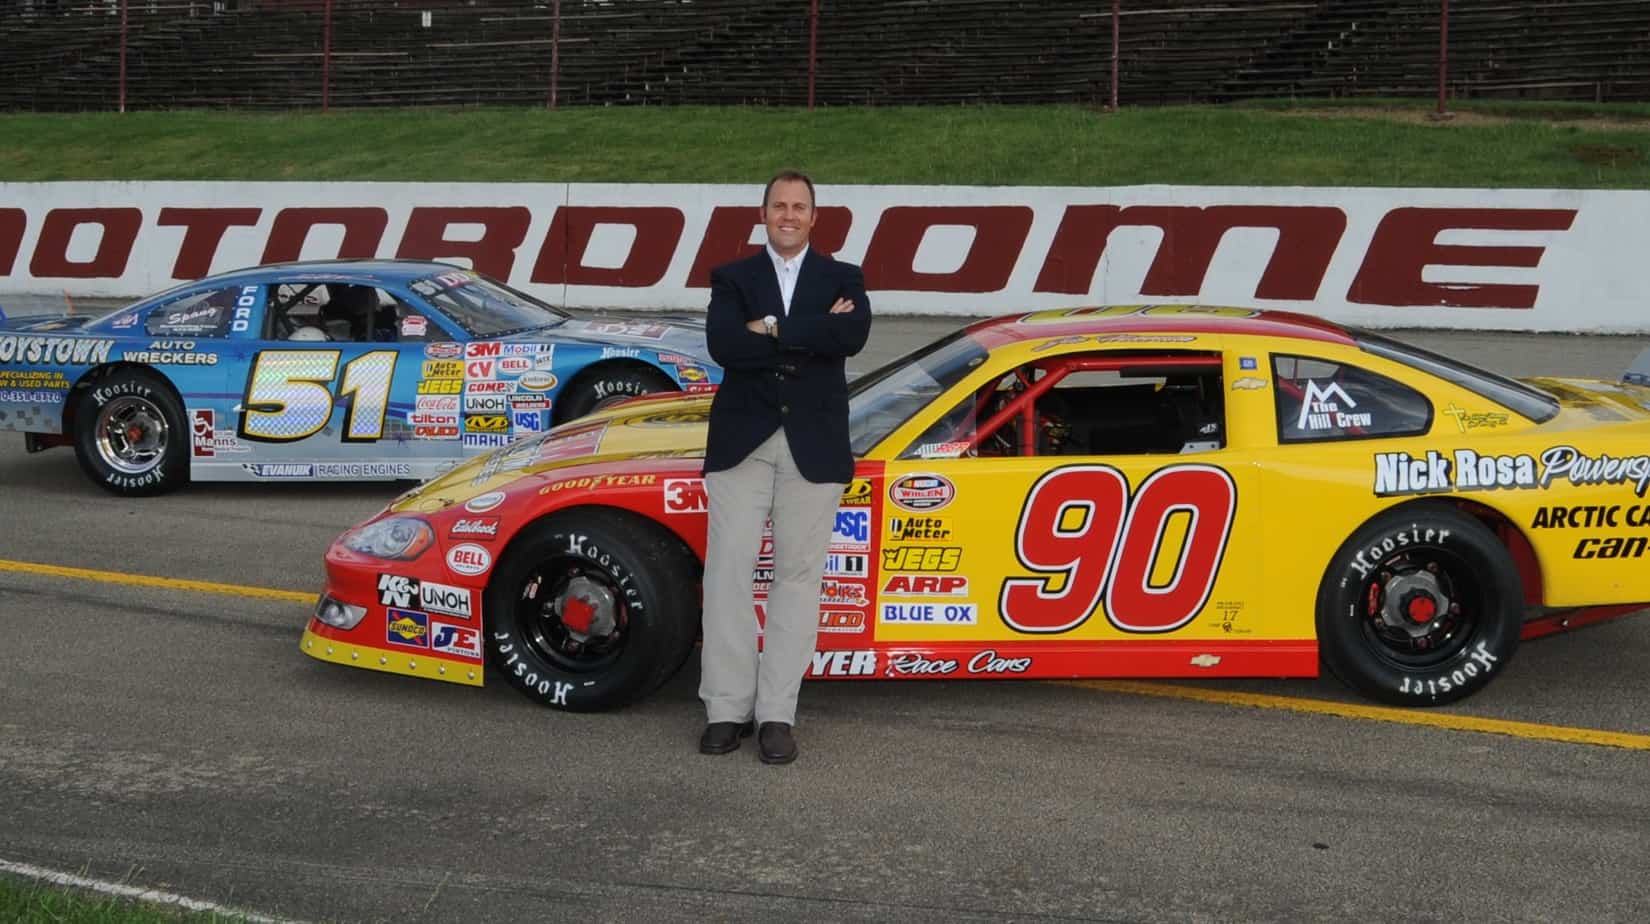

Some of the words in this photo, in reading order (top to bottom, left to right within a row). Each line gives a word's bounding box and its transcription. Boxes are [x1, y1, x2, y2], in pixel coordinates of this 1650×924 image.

[0, 203, 1579, 308] OTORDROME
[0, 336, 114, 363] OYSTOWN
[150, 341, 196, 350] AUTO
[467, 343, 500, 357] 3M
[504, 345, 537, 353] Mobil
[123, 352, 217, 364] WRECKERS
[502, 360, 529, 369] BELL
[433, 369, 462, 377] Meter
[467, 361, 492, 378] CV
[44, 381, 71, 389] PARTS
[417, 381, 463, 394] JEGS
[93, 381, 151, 406] Hoosier
[237, 349, 400, 443] 51
[466, 399, 504, 409] UNOH
[1312, 401, 1338, 412] The
[411, 413, 456, 424] tilton
[515, 412, 540, 431] USG
[1309, 413, 1332, 428] Hill
[1337, 412, 1372, 427] Crew
[319, 464, 361, 475] RACING
[364, 464, 410, 475] ENGINES
[1374, 451, 1452, 496] Nick
[1454, 449, 1536, 490] Rosa
[905, 517, 942, 528] Auto
[1532, 506, 1621, 529] ARCTIC
[903, 528, 950, 539] Meter
[998, 462, 1238, 634] 90
[1351, 523, 1449, 580] Hoosier
[454, 550, 485, 566] BELL
[883, 547, 962, 571] JEGS
[566, 533, 643, 611] Hoosier
[883, 577, 967, 593] ARP
[422, 585, 470, 613] UNOH
[885, 605, 934, 621] BLUE
[944, 605, 972, 621] OX
[434, 627, 477, 651] JE
[495, 631, 575, 705] Hoosier
[967, 650, 1031, 673] Cars
[1400, 640, 1497, 699] Hoosier
